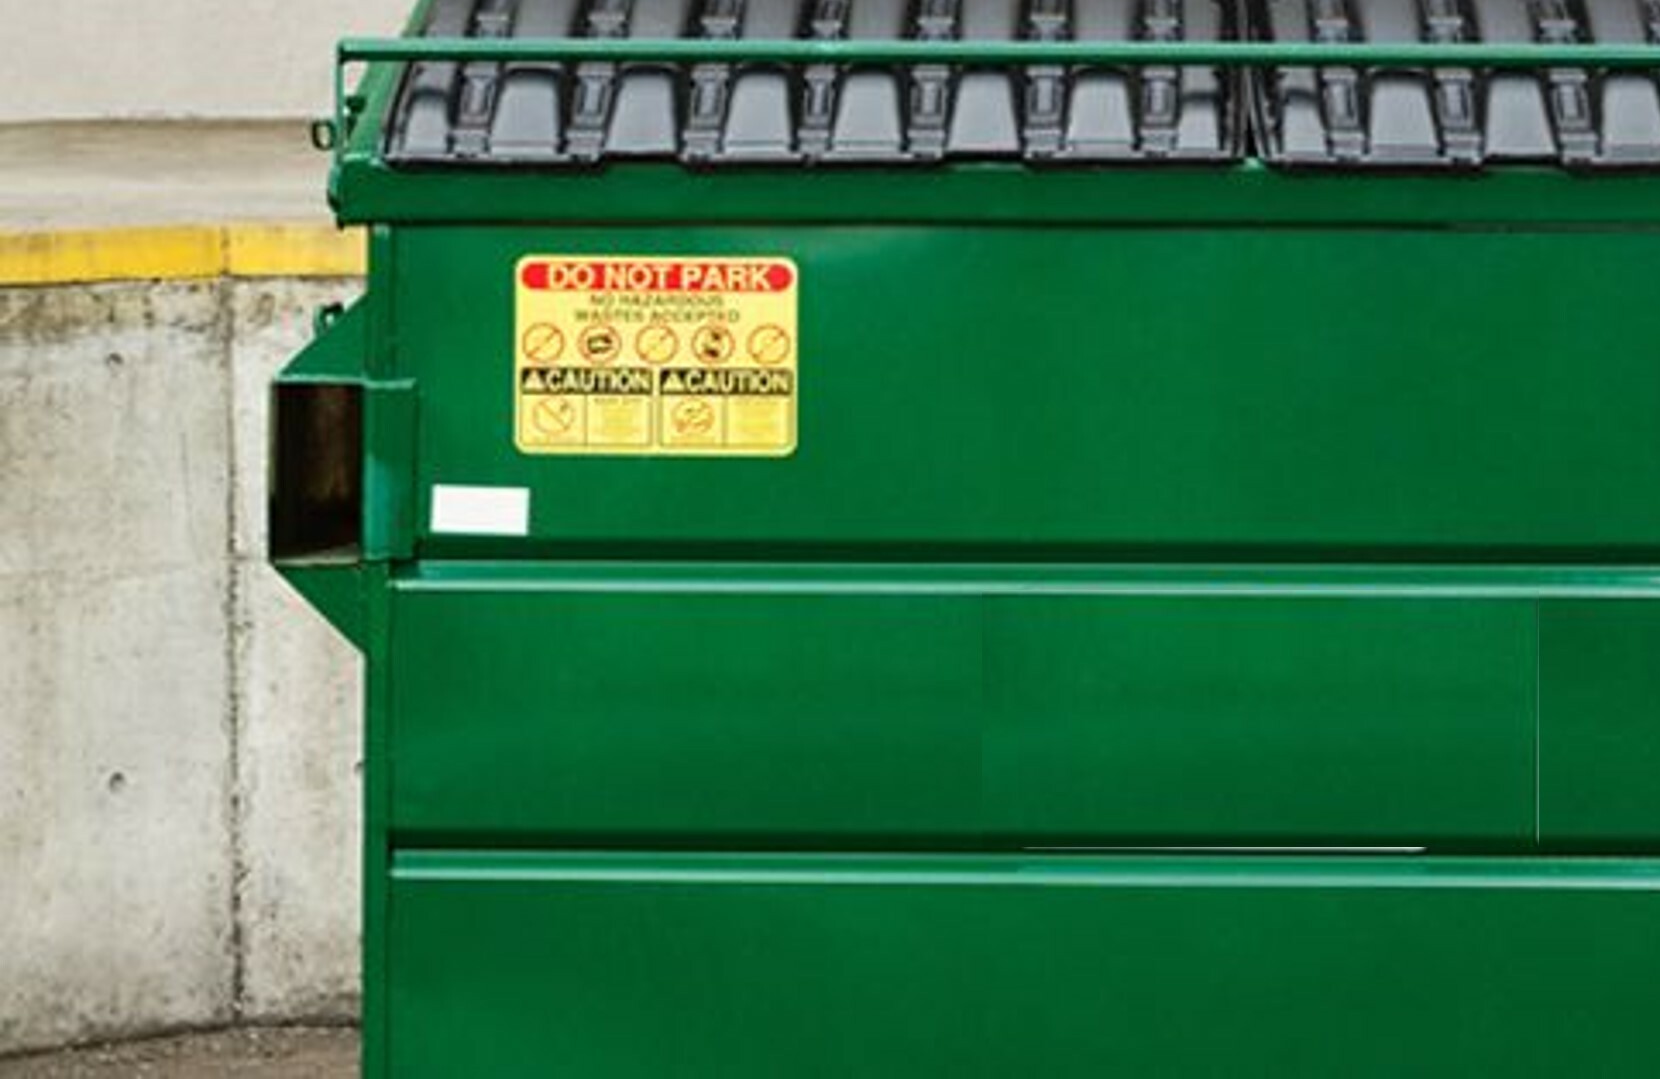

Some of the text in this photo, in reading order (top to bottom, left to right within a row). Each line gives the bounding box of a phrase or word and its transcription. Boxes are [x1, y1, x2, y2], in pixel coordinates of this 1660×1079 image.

[548, 266, 771, 291] DO NOT PARK
[590, 294, 724, 308] NO HAZARDOUS
[575, 310, 741, 324] WASTES ACCEPTED
[546, 371, 651, 393] CAUTION
[686, 371, 790, 393] CAUTION
